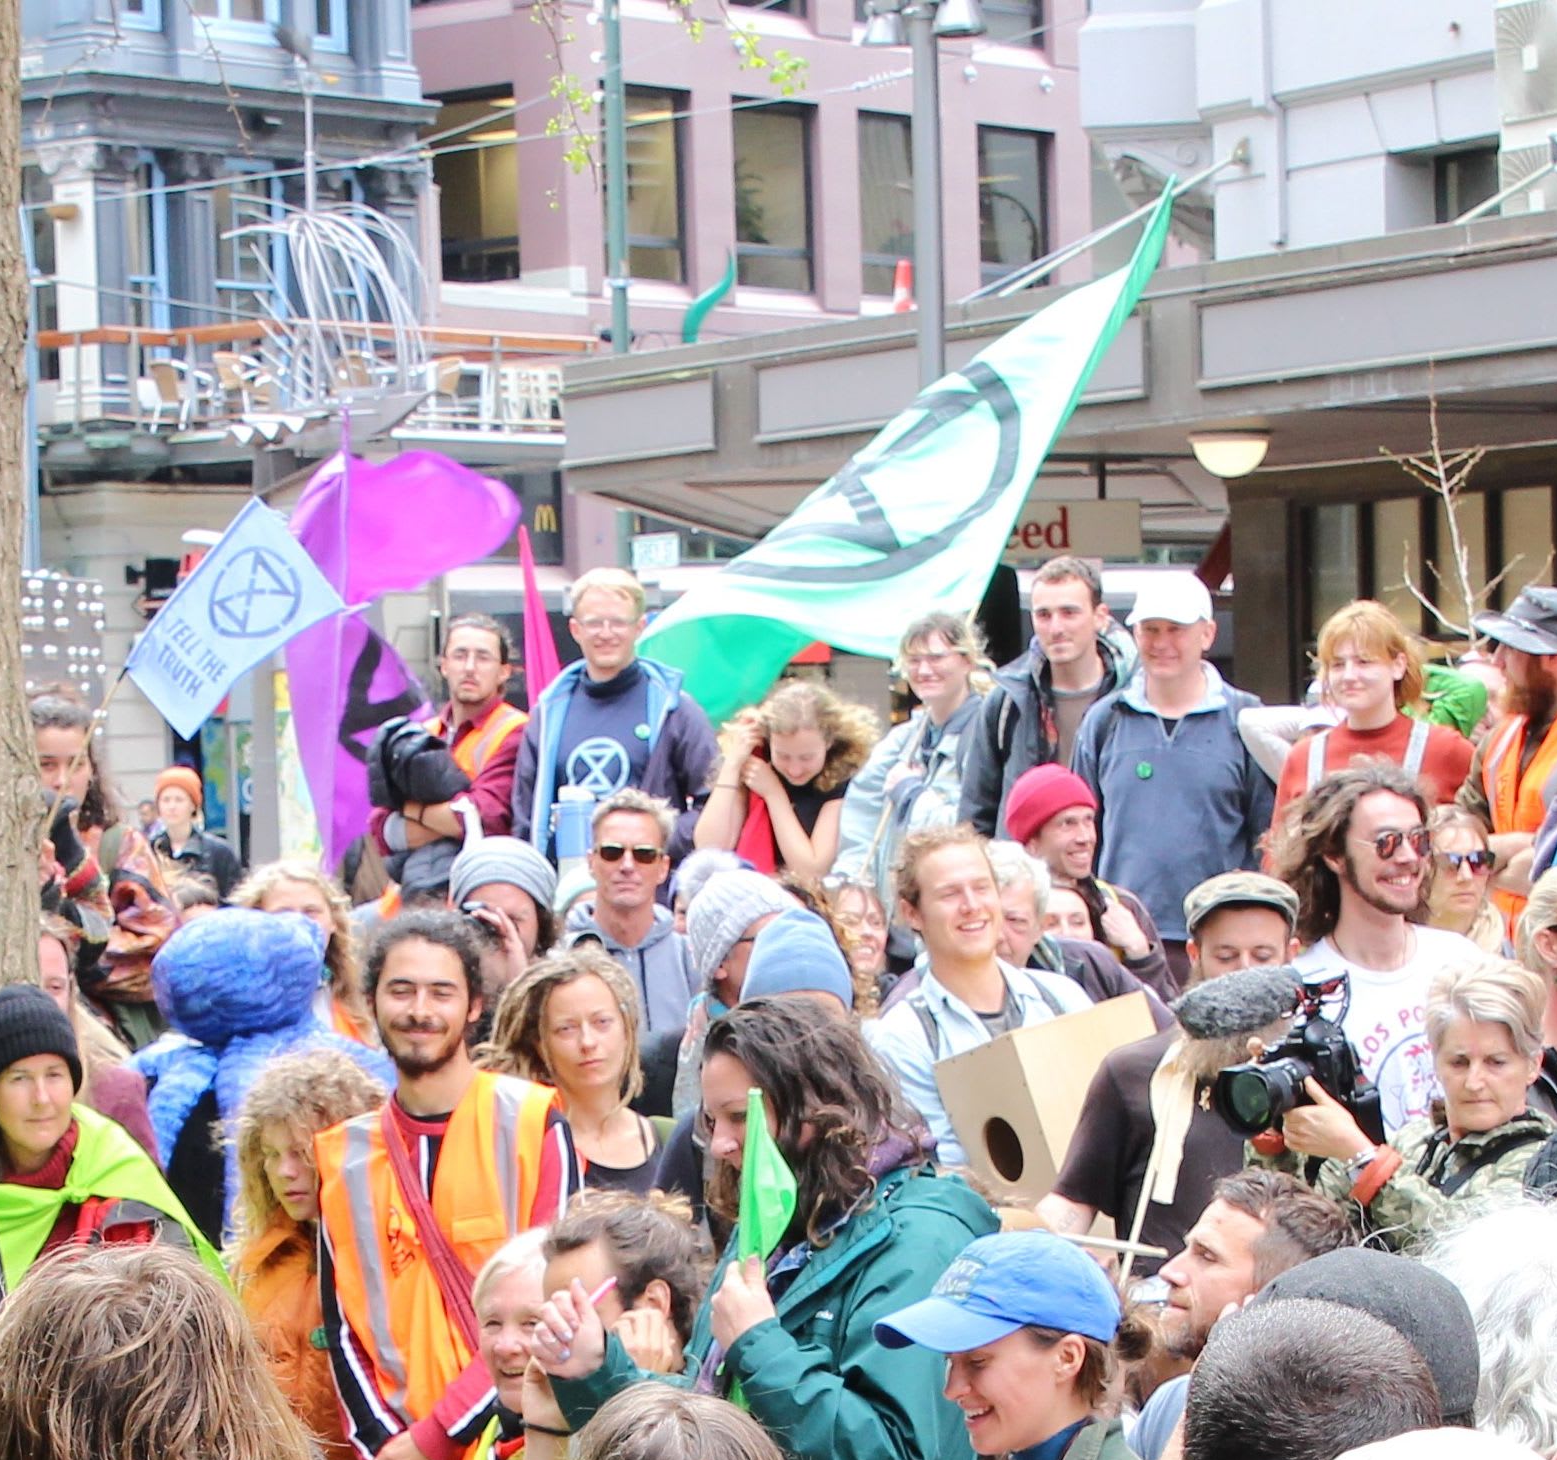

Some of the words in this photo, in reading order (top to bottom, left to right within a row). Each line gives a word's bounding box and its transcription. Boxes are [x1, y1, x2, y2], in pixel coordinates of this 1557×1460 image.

[158, 643, 203, 699] TRUTH
[167, 617, 202, 656] TELL
[196, 648, 228, 683] THE
[1361, 1022, 1390, 1067] LOS
[1397, 1005, 1426, 1028] PO
